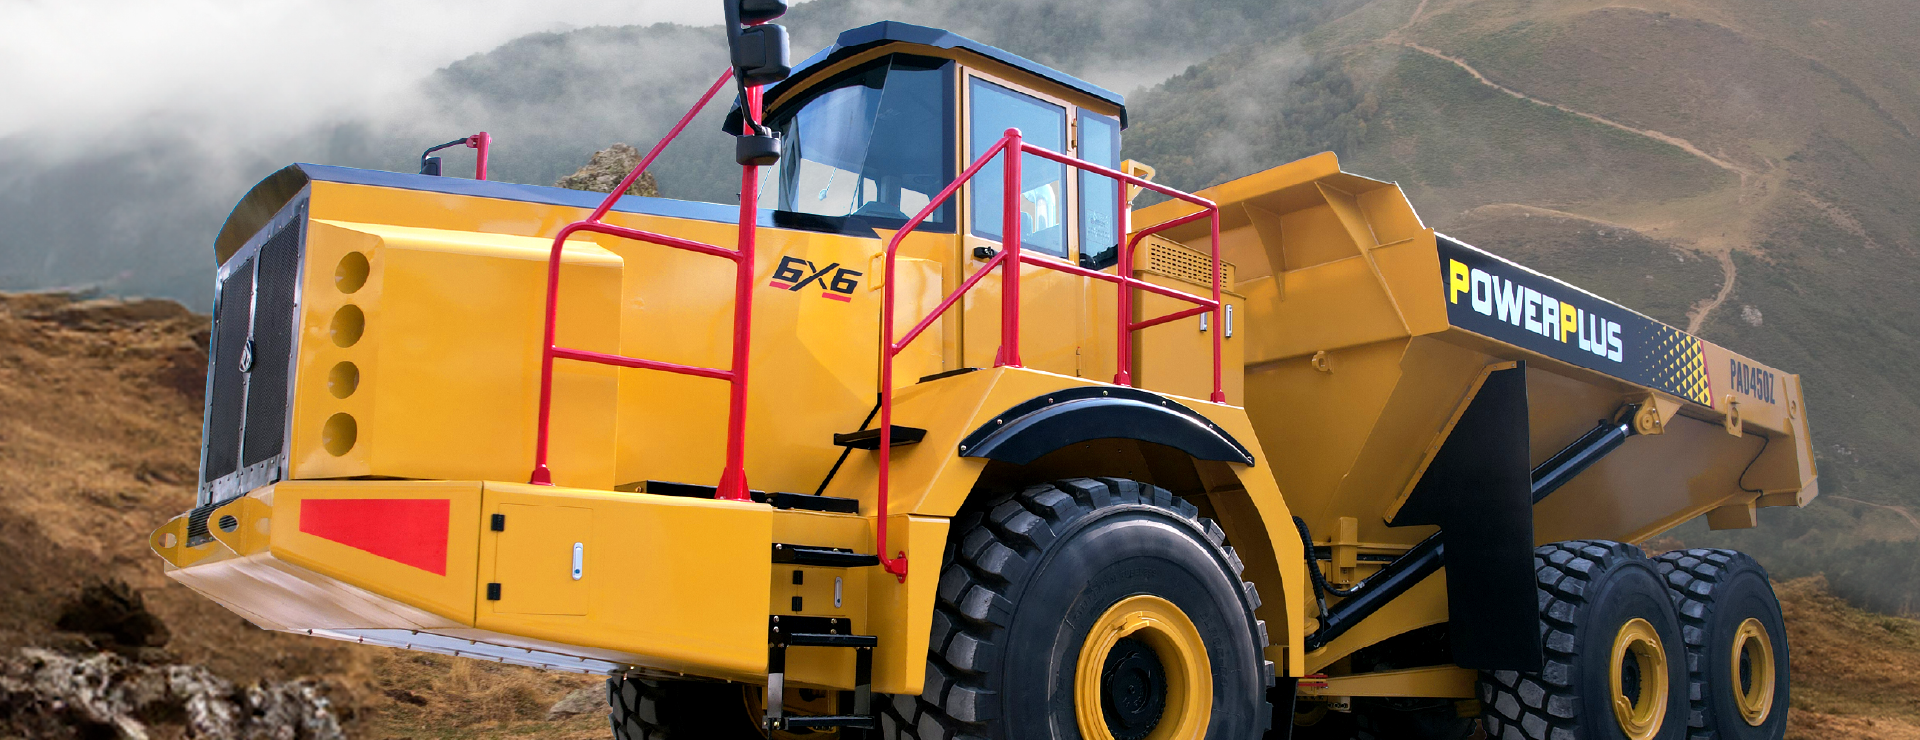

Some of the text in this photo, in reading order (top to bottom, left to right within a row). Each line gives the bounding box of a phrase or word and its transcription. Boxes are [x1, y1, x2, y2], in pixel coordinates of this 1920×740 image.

[772, 255, 863, 294] 6X6
[1450, 258, 1623, 363] POWERPLUS
[1730, 358, 1775, 405] PAD450Z
